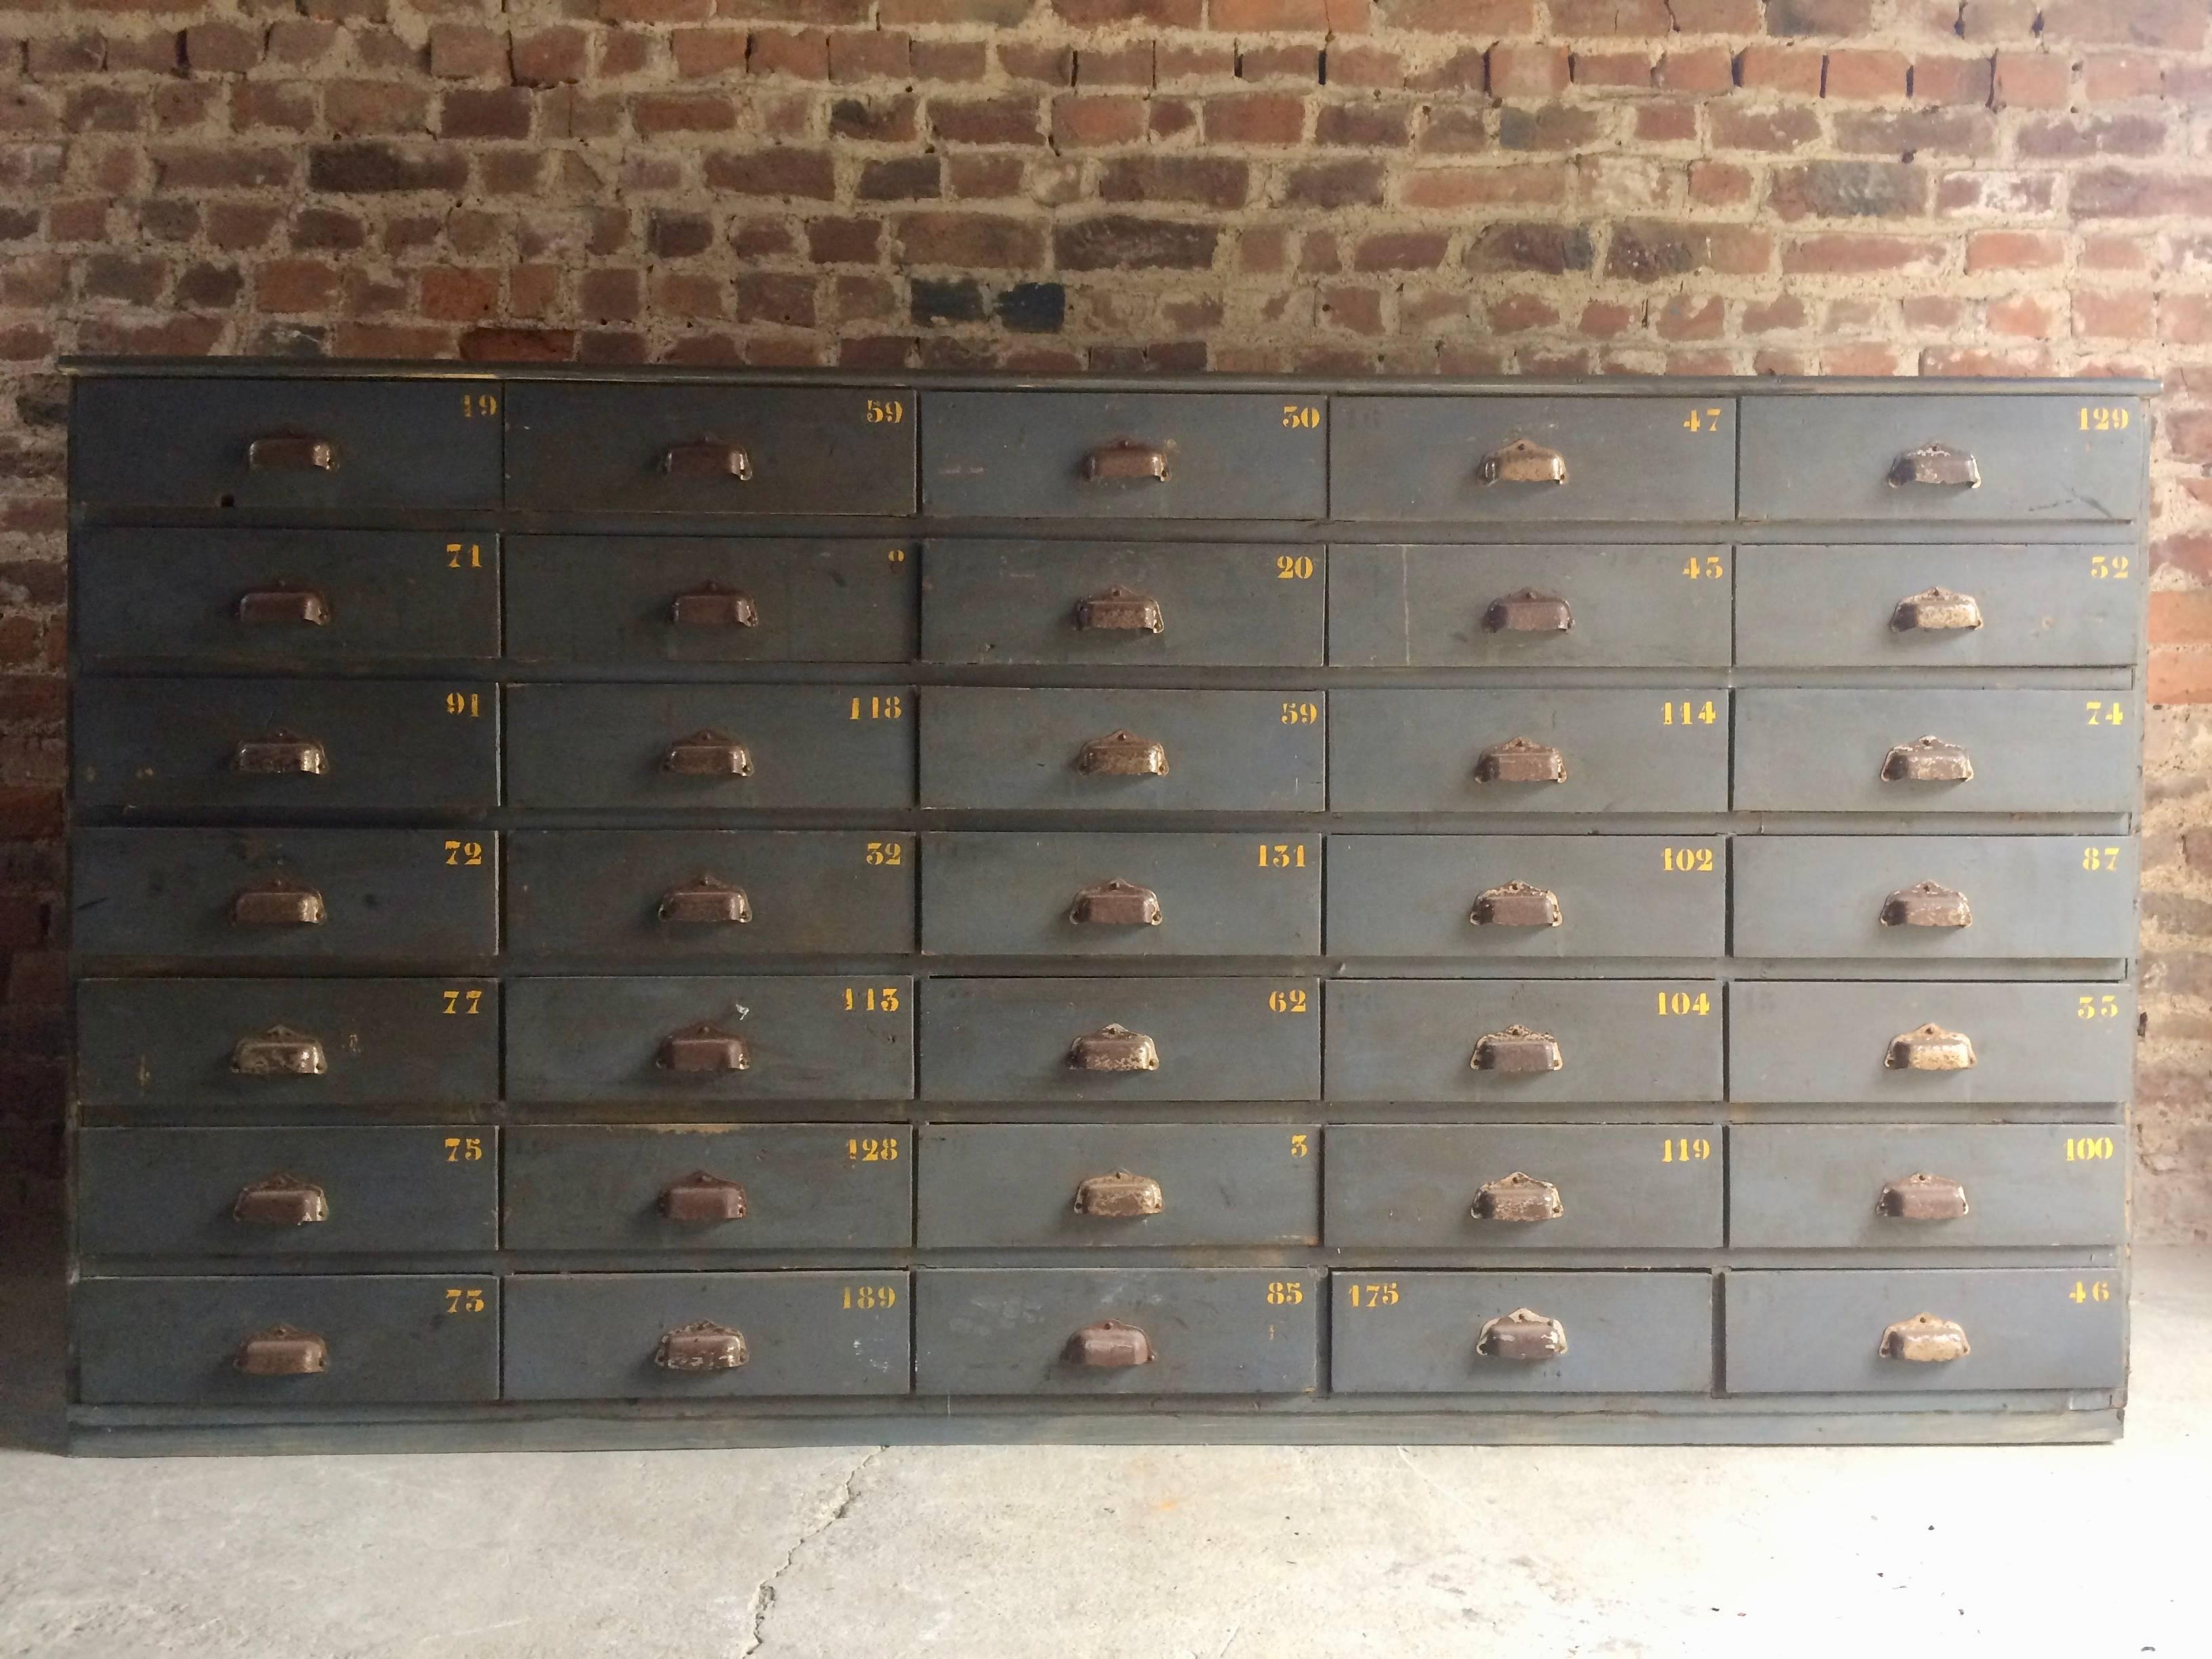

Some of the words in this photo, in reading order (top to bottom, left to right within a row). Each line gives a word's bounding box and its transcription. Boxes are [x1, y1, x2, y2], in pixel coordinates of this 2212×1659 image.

[867, 401, 902, 423] 59
[1683, 409, 1721, 432] 47
[2080, 408, 2130, 431] 129
[447, 544, 482, 567] 71
[1277, 556, 1313, 579] 20
[447, 693, 478, 717] 91
[851, 697, 901, 719] 118
[1282, 703, 1317, 724] 59
[1664, 701, 1716, 724] 114
[2087, 701, 2123, 724] 74
[445, 841, 481, 865] 72
[1664, 848, 1713, 871] 102
[2083, 848, 2120, 870] 87
[444, 991, 482, 1014] 77
[1269, 990, 1306, 1012] 62
[1659, 992, 1710, 1015] 104
[445, 1139, 482, 1162] 75
[849, 1139, 897, 1161] 128
[1662, 1139, 1709, 1162] 119
[2067, 1137, 2113, 1161] 100
[844, 1286, 895, 1309] 189
[1267, 1282, 1303, 1304] 85
[1349, 1283, 1399, 1307] 175
[2069, 1282, 2109, 1303] 46
